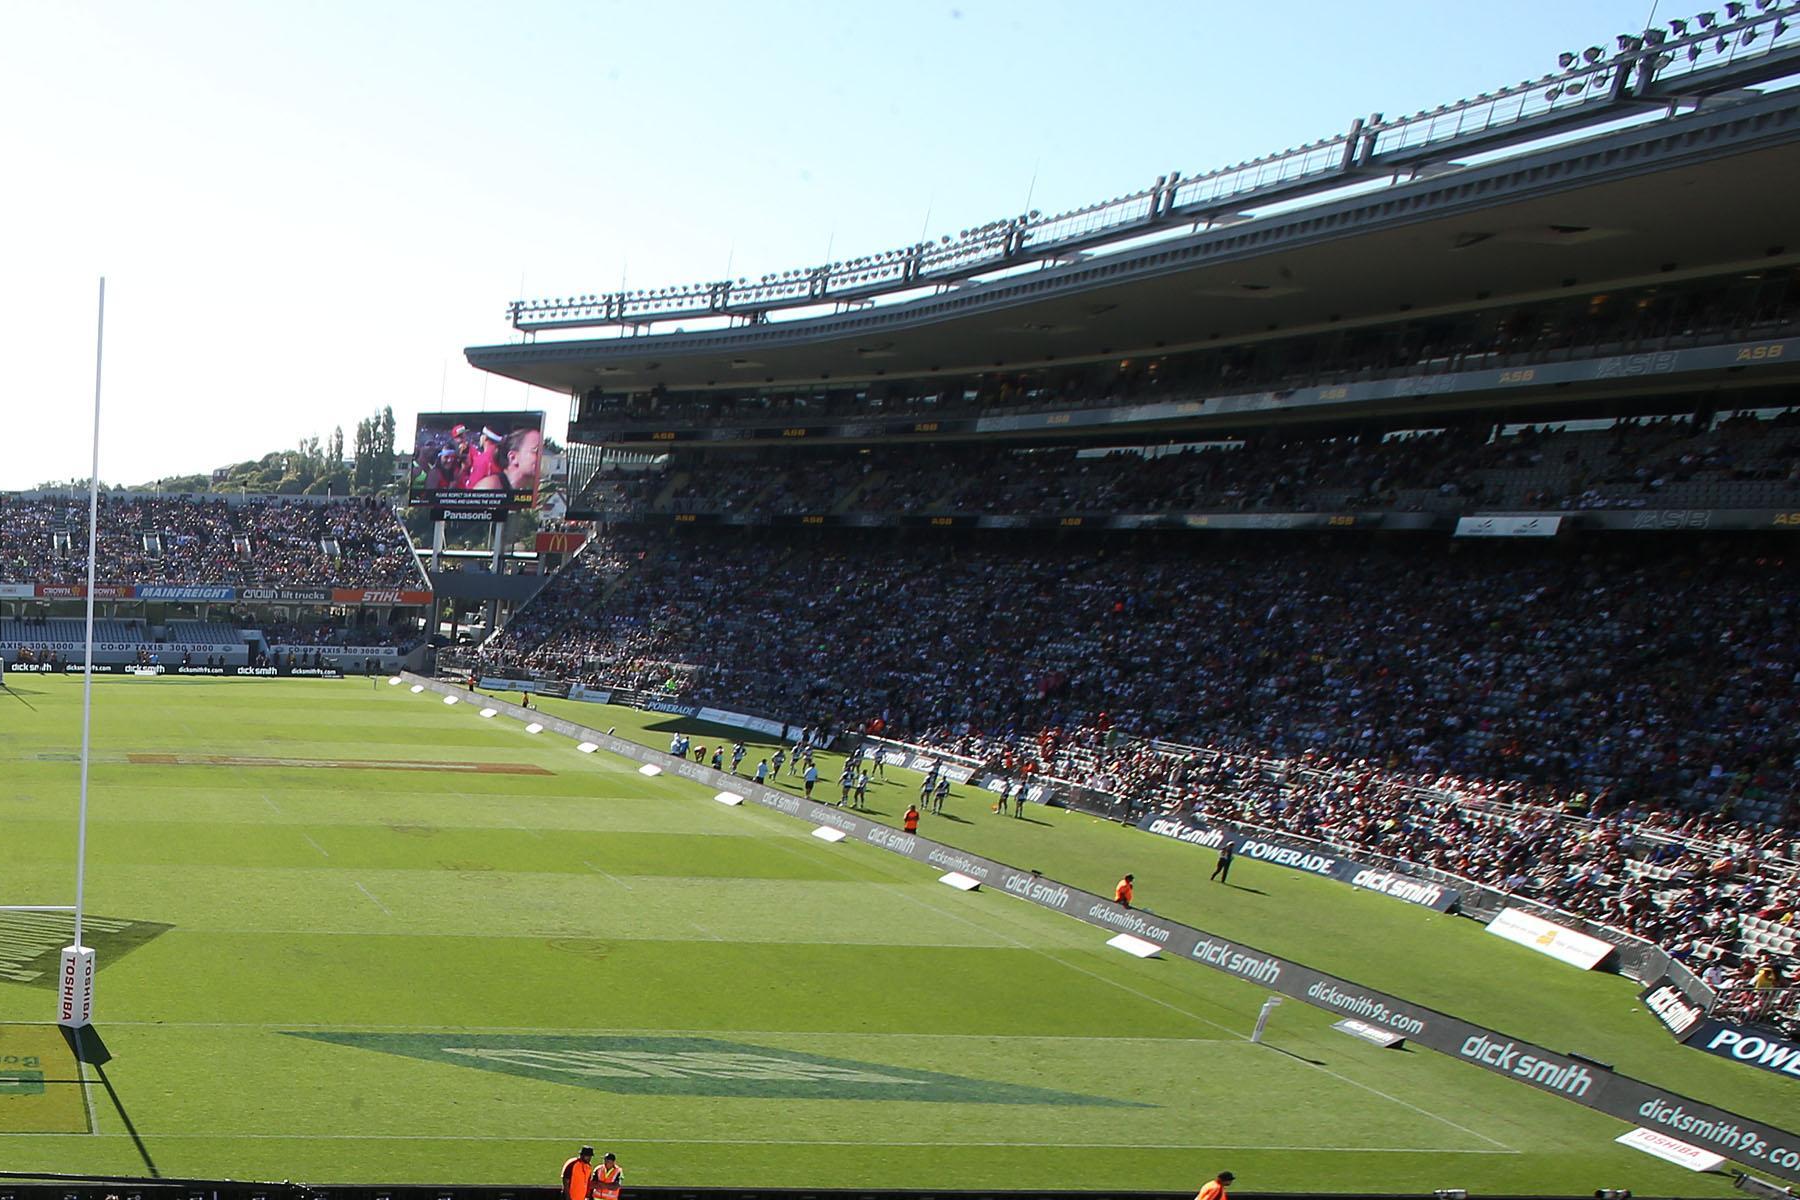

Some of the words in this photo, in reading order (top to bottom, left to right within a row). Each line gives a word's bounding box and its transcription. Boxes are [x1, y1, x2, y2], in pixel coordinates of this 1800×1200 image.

[1738, 345, 1785, 360] ASB
[1499, 369, 1536, 384] ASB
[443, 510, 492, 520] Panasonic
[1329, 516, 1354, 526] ASB
[1634, 510, 1711, 530] ASB
[1773, 513, 1800, 525] AS
[43, 587, 72, 596] CROWN
[91, 587, 117, 596] ROWN
[141, 588, 230, 599] MAINFREIGHT
[281, 590, 296, 600] lift
[298, 590, 326, 600] trucks
[362, 591, 403, 602] STIHL
[101, 643, 131, 651] CO-OP
[191, 644, 214, 652] 3000
[316, 647, 342, 655] TAXIS
[12, 662, 29, 671] dick
[125, 664, 142, 674] dick
[237, 665, 255, 675] dick
[256, 666, 277, 675] smith
[291, 667, 336, 676] dicksmith9s.com
[647, 700, 697, 717] POWERADE
[762, 790, 780, 808] dick
[779, 796, 800, 815] smith
[868, 826, 888, 847] dick
[887, 832, 916, 855] smith
[1149, 818, 1178, 838] dick
[1178, 826, 1224, 849] smith
[928, 848, 989, 880] dicksmith9s.com
[1239, 841, 1336, 875] POWERADE
[1006, 872, 1032, 895] dick
[1032, 882, 1069, 909] smith
[1352, 868, 1387, 892] dick
[1386, 877, 1442, 907] smith
[1088, 902, 1170, 943] dicksmith9s.com
[1192, 937, 1230, 966] dick
[1229, 951, 1282, 985] smith
[62, 956, 77, 1021] TOSHIBA
[81, 956, 93, 1022] TOSHIBA
[1307, 980, 1424, 1036] dicksmith9s.com
[1460, 1034, 1519, 1071] dick
[1513, 1053, 1593, 1098] smith
[1636, 1129, 1701, 1158] TOSHIBA
